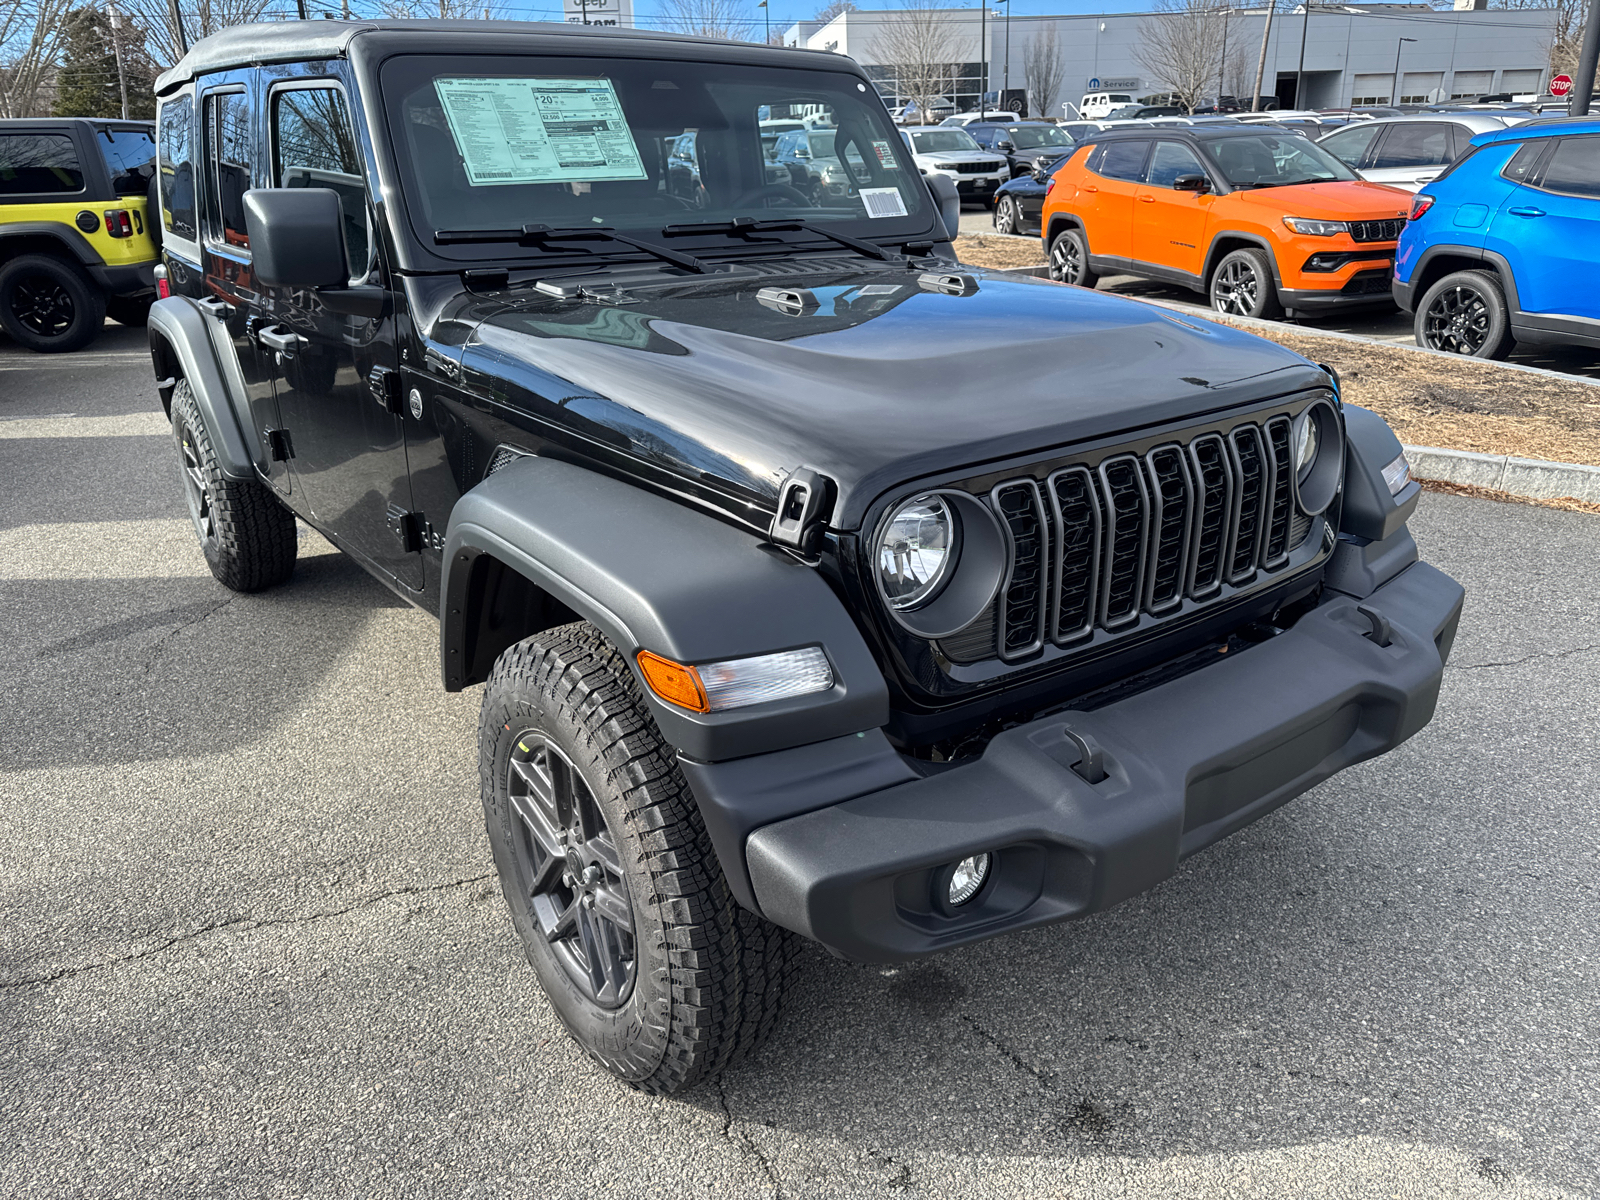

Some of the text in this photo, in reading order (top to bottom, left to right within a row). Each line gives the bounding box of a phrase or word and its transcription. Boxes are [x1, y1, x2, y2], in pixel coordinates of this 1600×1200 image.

[1103, 80, 1136, 88] Service
[1551, 81, 1571, 90] STOP
[540, 95, 553, 104] 20
